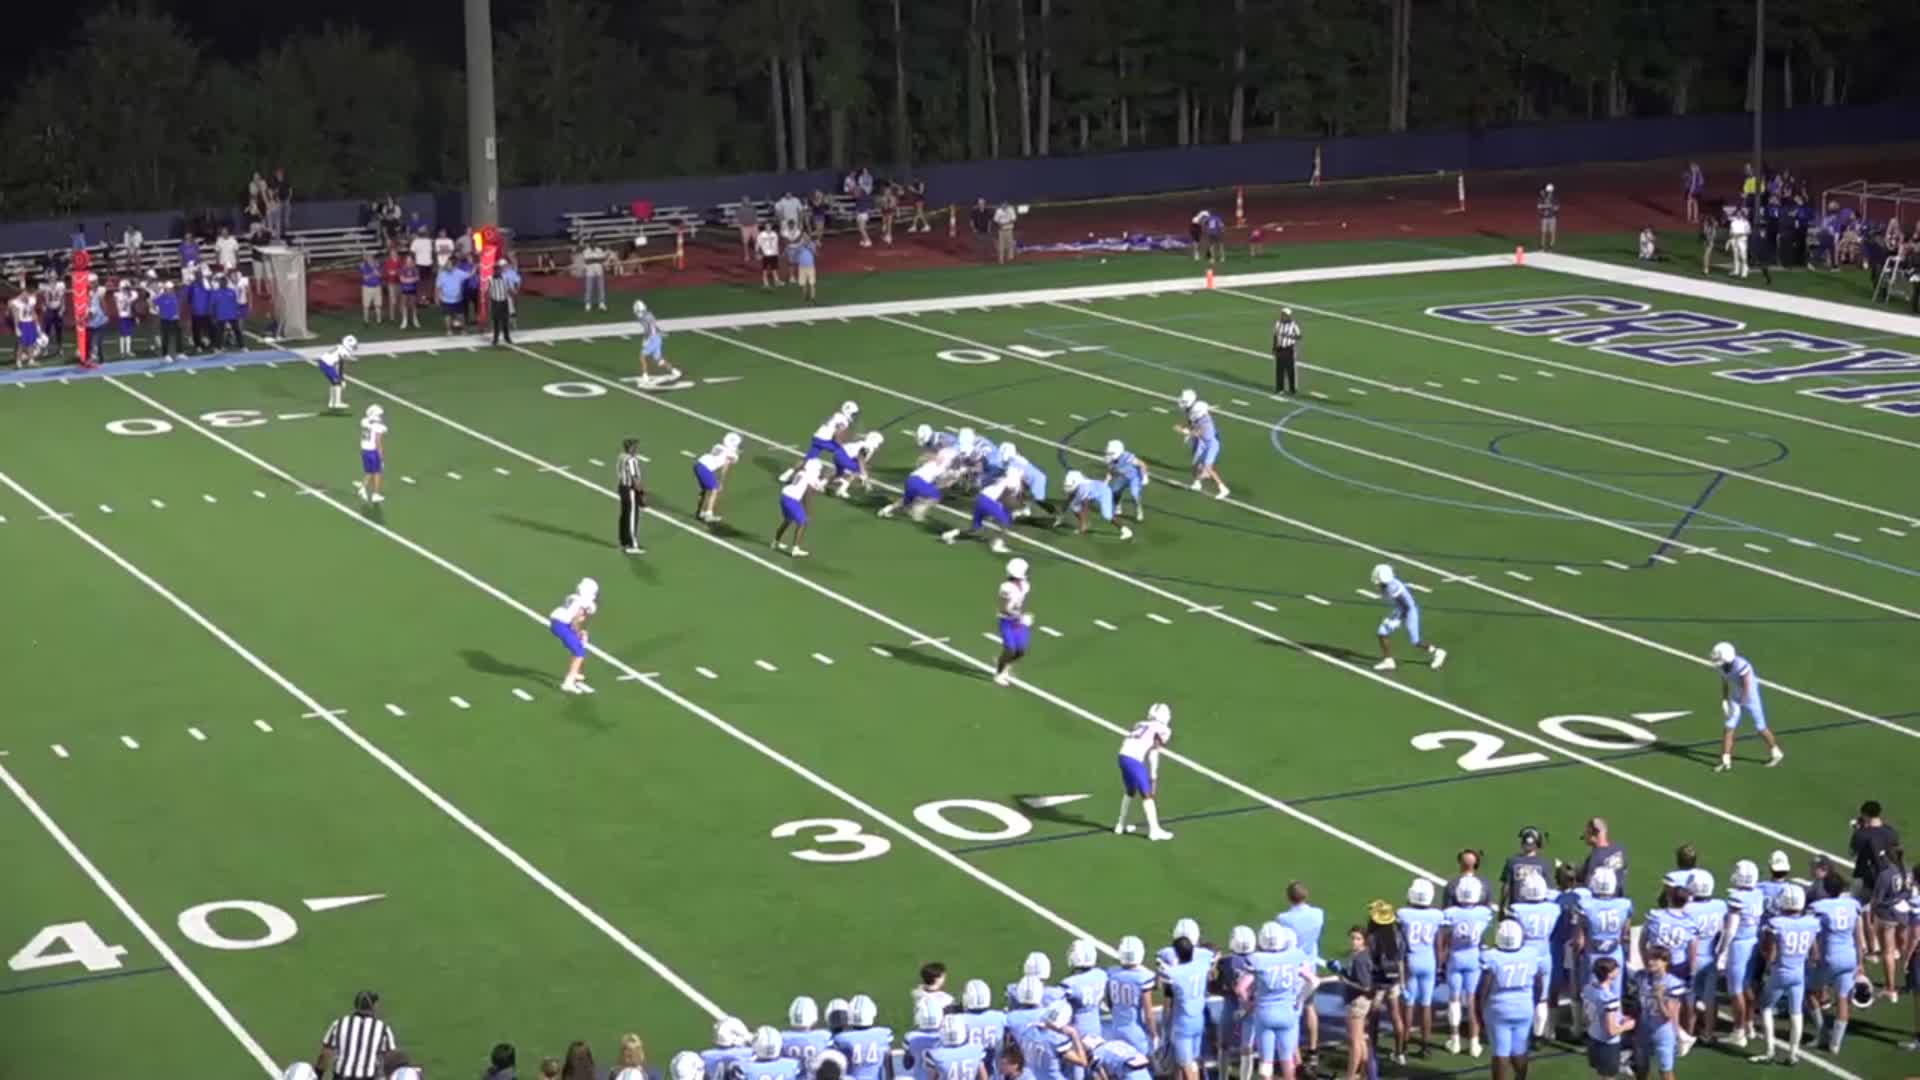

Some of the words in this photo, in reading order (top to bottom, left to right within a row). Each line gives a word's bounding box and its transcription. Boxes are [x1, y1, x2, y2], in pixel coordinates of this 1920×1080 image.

[1598, 909, 1621, 932] 15
[1785, 930, 1811, 955] 98
[1267, 964, 1293, 990] 75
[1503, 963, 1530, 988] 77
[1109, 979, 1132, 1006] 80
[968, 1024, 997, 1048] 65
[852, 1041, 878, 1064] 44
[948, 1058, 975, 1080] 45
